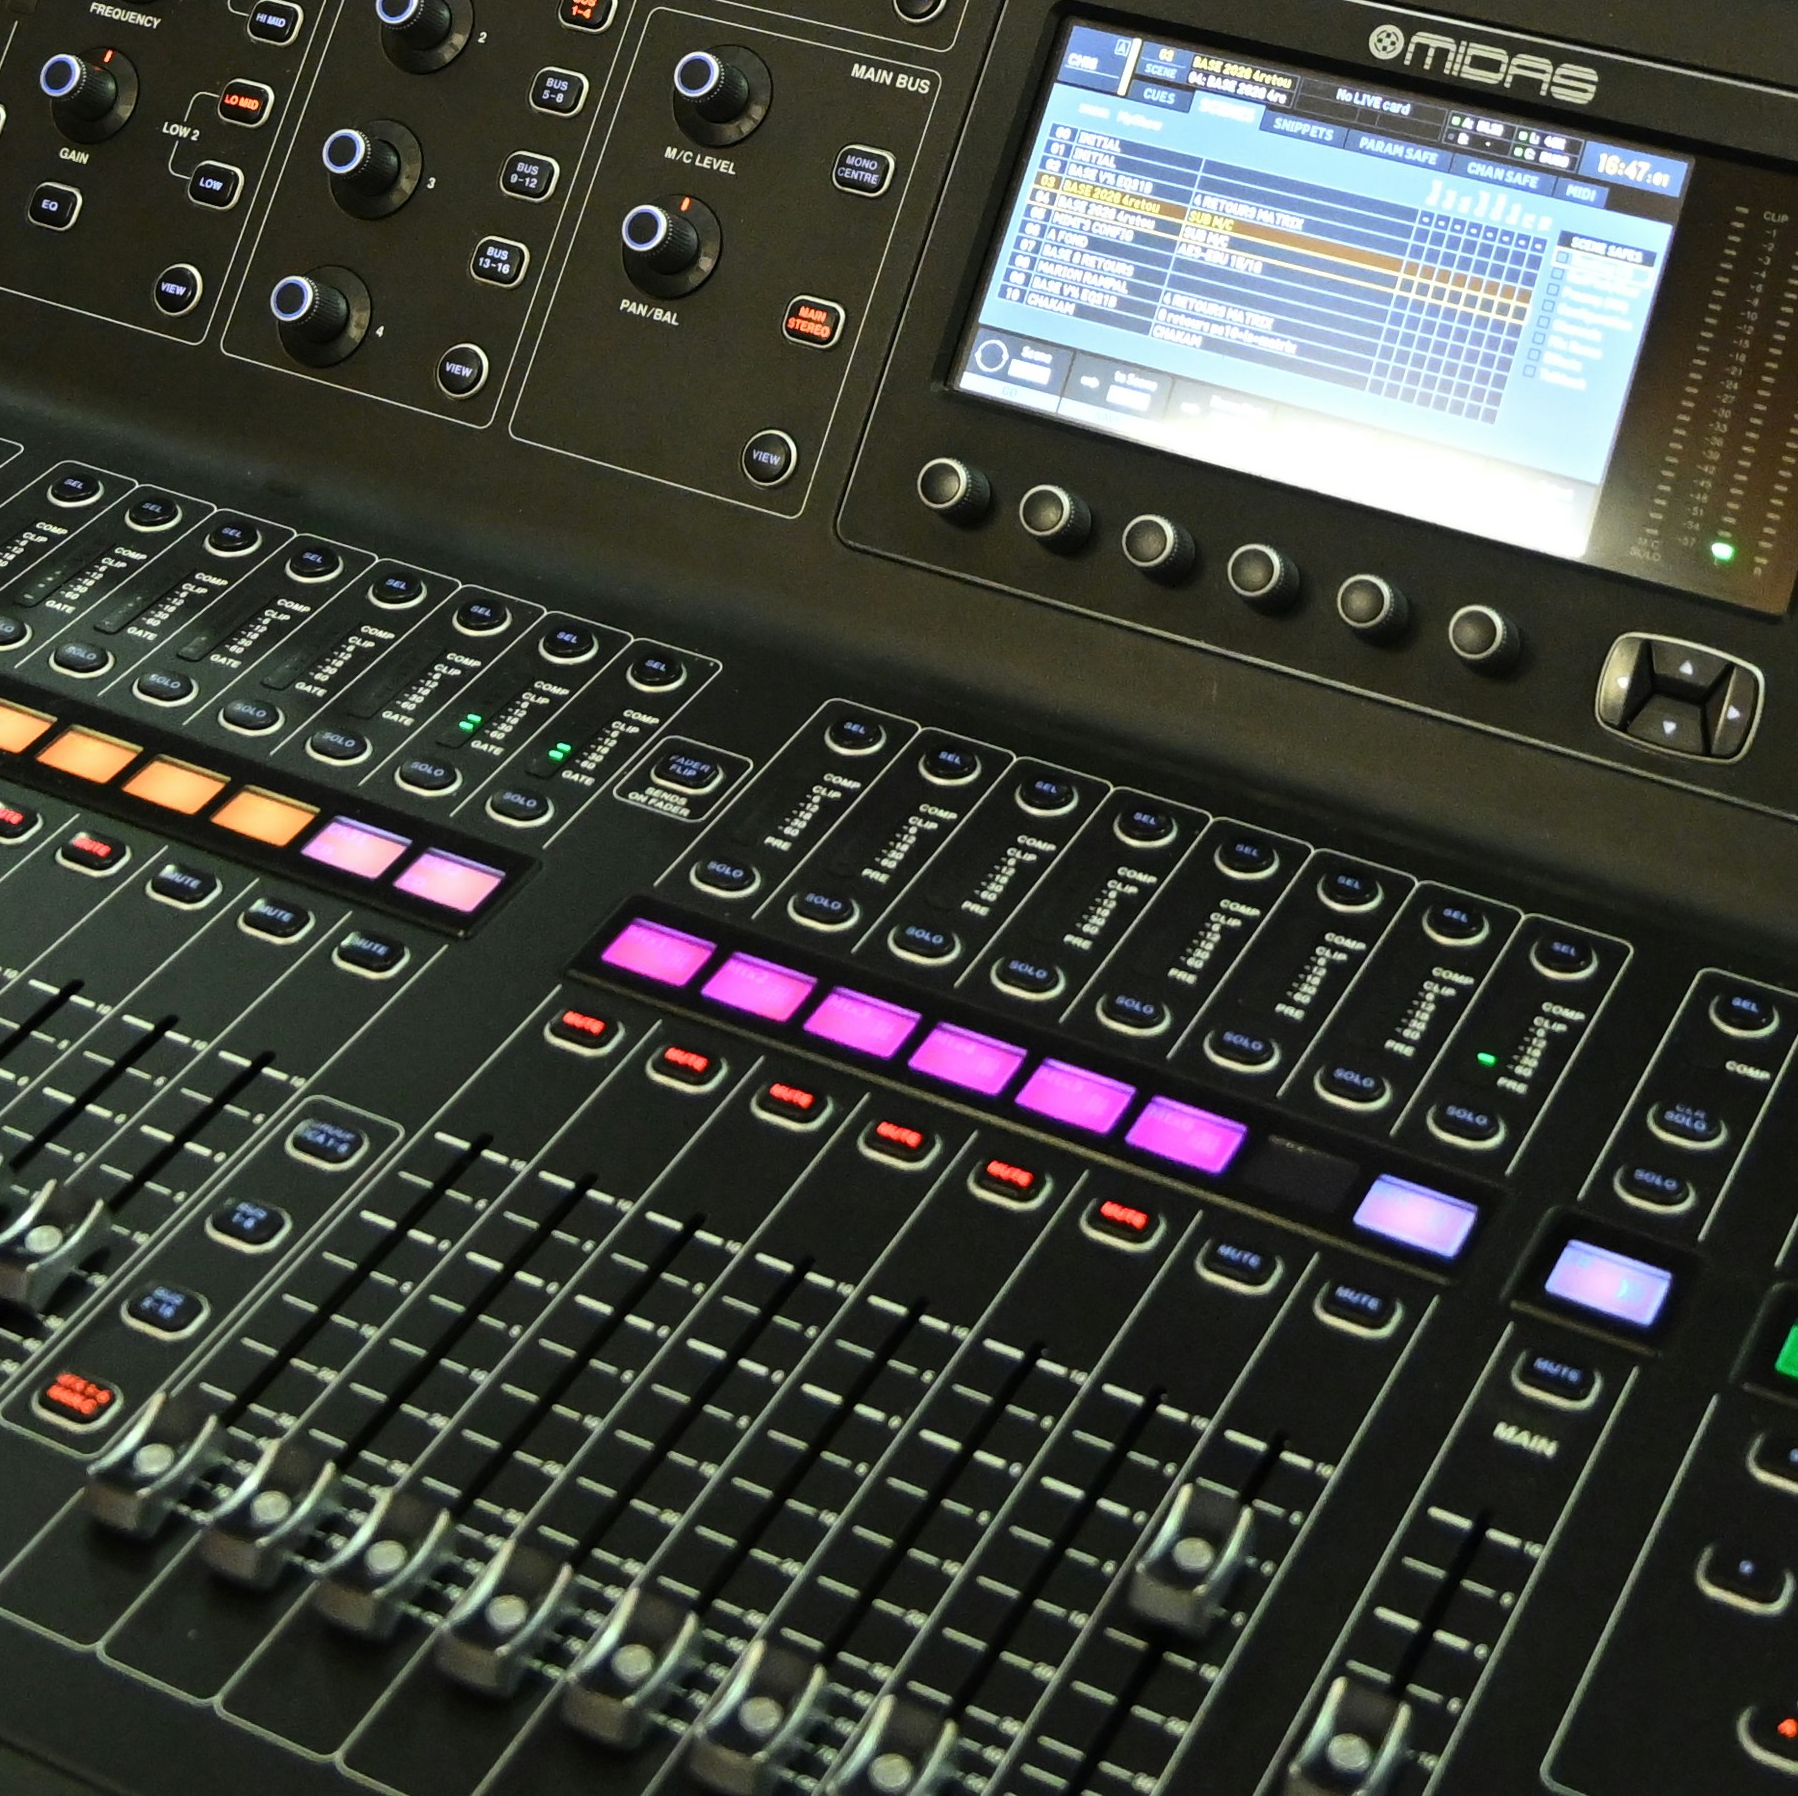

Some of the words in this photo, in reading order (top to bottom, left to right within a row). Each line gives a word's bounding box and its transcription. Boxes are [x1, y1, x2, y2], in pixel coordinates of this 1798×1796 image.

[89, 1, 162, 29] FREQUENCY
[255, 12, 268, 23] HI
[266, 15, 286, 28] MID
[571, 4, 592, 19] 1-4
[477, 31, 488, 44] 2
[1404, 30, 1599, 106] MIDAS
[545, 77, 569, 91] BUS
[850, 62, 892, 87] MAIN
[894, 72, 931, 95] BUS
[224, 94, 241, 108] LO
[240, 96, 259, 110] MID
[541, 89, 565, 103] 5-8
[1142, 88, 1175, 104] CUES
[1336, 87, 1352, 103] No
[1354, 90, 1382, 109] LIVE
[1382, 98, 1411, 117] card
[162, 121, 192, 138] LOW
[190, 129, 200, 141] 2
[1273, 117, 1334, 142] SNIPPETS
[59, 147, 90, 165] GAIN
[1359, 135, 1402, 160] PARAM
[1401, 145, 1438, 165] SAFE
[516, 162, 539, 176] BUS
[664, 146, 694, 164] M/C
[694, 153, 736, 175] LEVEL
[845, 154, 878, 171] MONO
[199, 177, 224, 191] LOW
[426, 176, 437, 189] 3
[509, 173, 538, 189] 9-12
[837, 167, 880, 185] CENTRE
[1467, 162, 1505, 183] CHAN
[1504, 168, 1539, 190] SAFE
[1566, 183, 1597, 202] MIDI
[41, 199, 59, 212] EQ
[486, 246, 509, 261] BUS
[478, 257, 511, 275] 13-16
[161, 281, 187, 296] VIEW
[619, 298, 679, 326] PAN/BAL
[798, 305, 828, 325] MAIN
[375, 325, 385, 338] 4
[787, 316, 832, 339] STEREO
[445, 361, 474, 378] VIEW
[752, 449, 782, 466] VIEW
[622, 709, 660, 725] COMP
[843, 722, 865, 735] SEL
[669, 763, 697, 777] FLIP
[823, 773, 862, 790] COMP
[644, 786, 688, 806] SENDS
[812, 785, 842, 800] CLIP
[628, 791, 649, 804] ON
[647, 797, 691, 817] FADER
[763, 835, 792, 851] PRE
[707, 861, 744, 879] SOLO
[1492, 1421, 1558, 1458] MAIN
